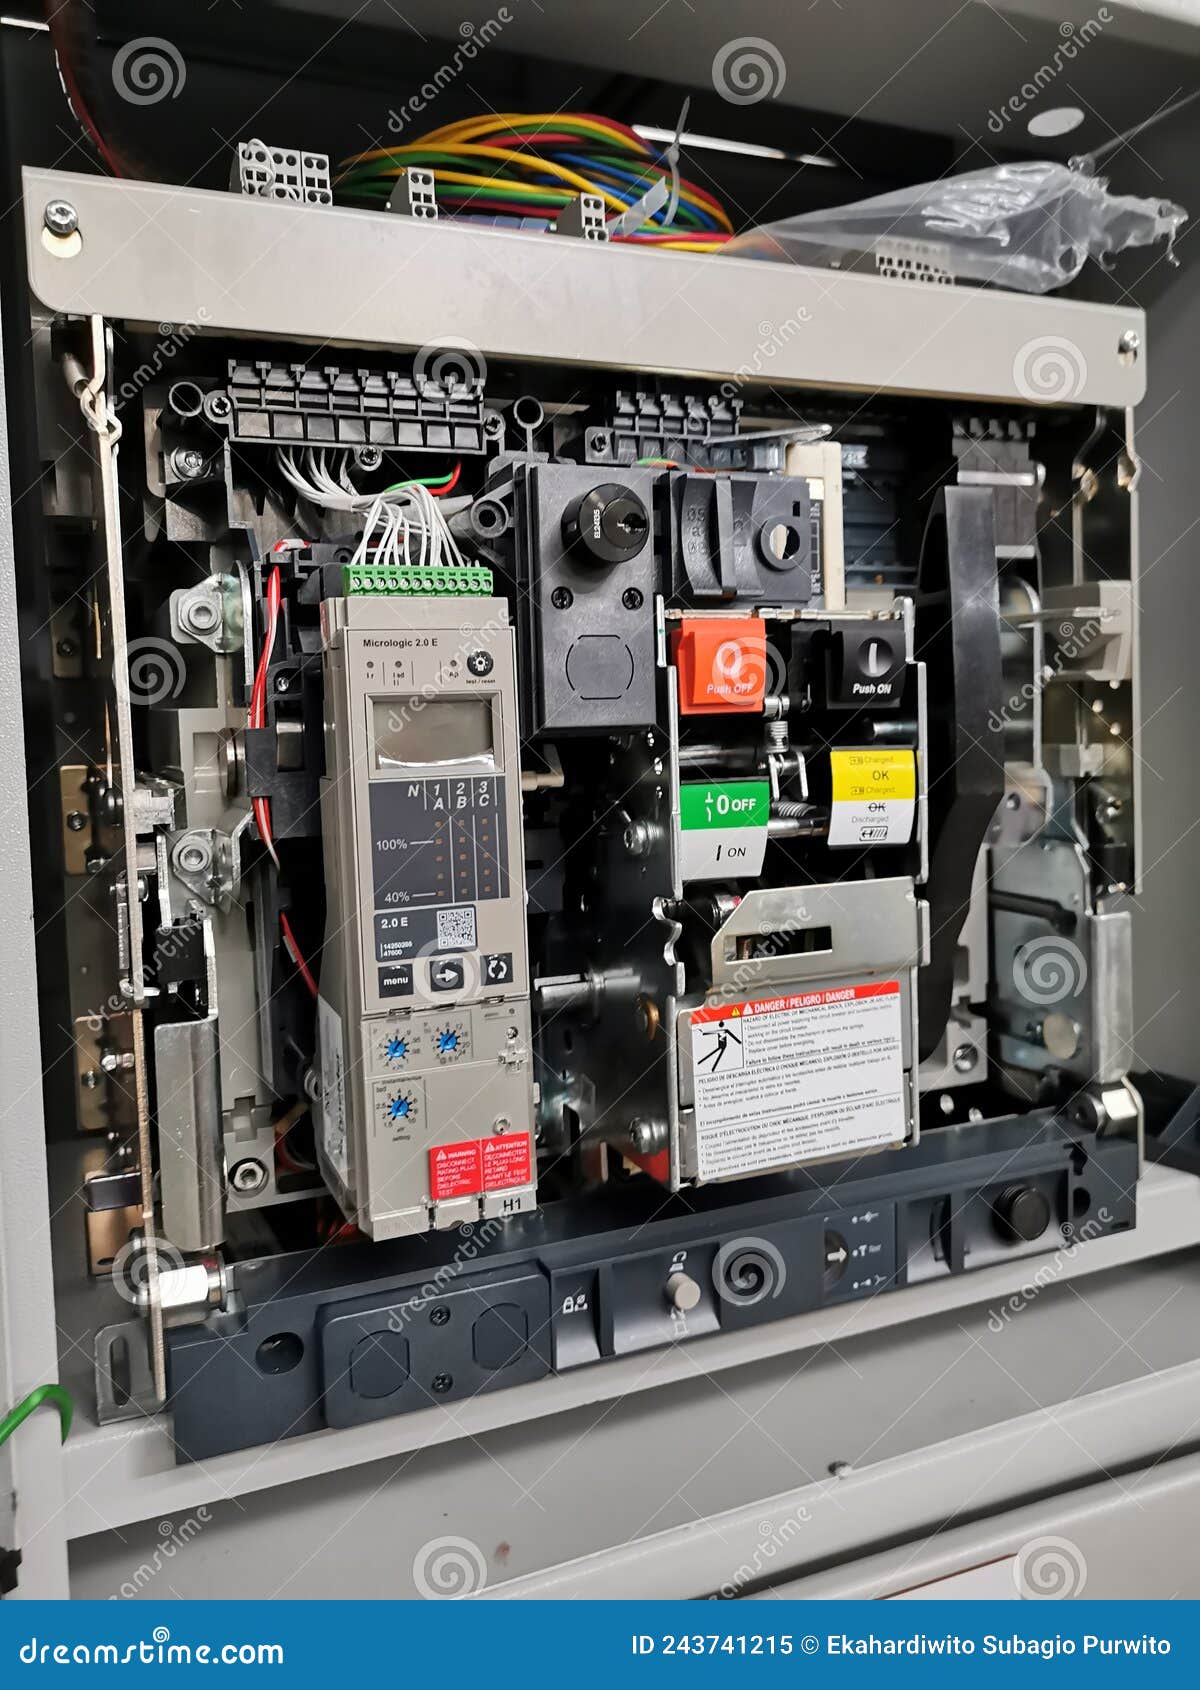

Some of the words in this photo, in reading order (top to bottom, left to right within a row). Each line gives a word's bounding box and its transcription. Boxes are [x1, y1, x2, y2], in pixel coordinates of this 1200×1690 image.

[363, 638, 413, 649] Micrologic
[415, 638, 429, 647] 2.0
[431, 638, 438, 647] E
[707, 683, 731, 695] Push
[734, 683, 753, 693] OFF
[852, 683, 876, 694] Push
[877, 683, 892, 694] ON
[872, 770, 890, 781] OK
[408, 784, 419, 797] N
[433, 784, 440, 796] 1
[456, 782, 465, 795] 2
[479, 781, 488, 793] 3
[433, 797, 444, 810] A
[456, 796, 467, 809] B
[479, 794, 489, 807] C
[731, 798, 757, 811] OFF
[868, 802, 887, 812] OK
[851, 815, 889, 824] Discharged
[376, 839, 408, 851] 100%
[727, 847, 746, 857] ON
[384, 891, 410, 903] 40%
[381, 918, 398, 929] 2.0
[401, 917, 408, 927] E
[383, 977, 409, 986] menu
[754, 999, 784, 1014] DANGER
[790, 993, 820, 1008] PELIGRO
[824, 988, 856, 1002] DANGER
[495, 1141, 528, 1151] ATTENTION
[448, 1149, 476, 1159] WARNING
[436, 1158, 475, 1169] DISCONNECT
[436, 1167, 459, 1176] RATING
[437, 1173, 461, 1182] BEFORE
[437, 1180, 471, 1189] DIELECTRIC
[503, 1198, 521, 1211] H1
